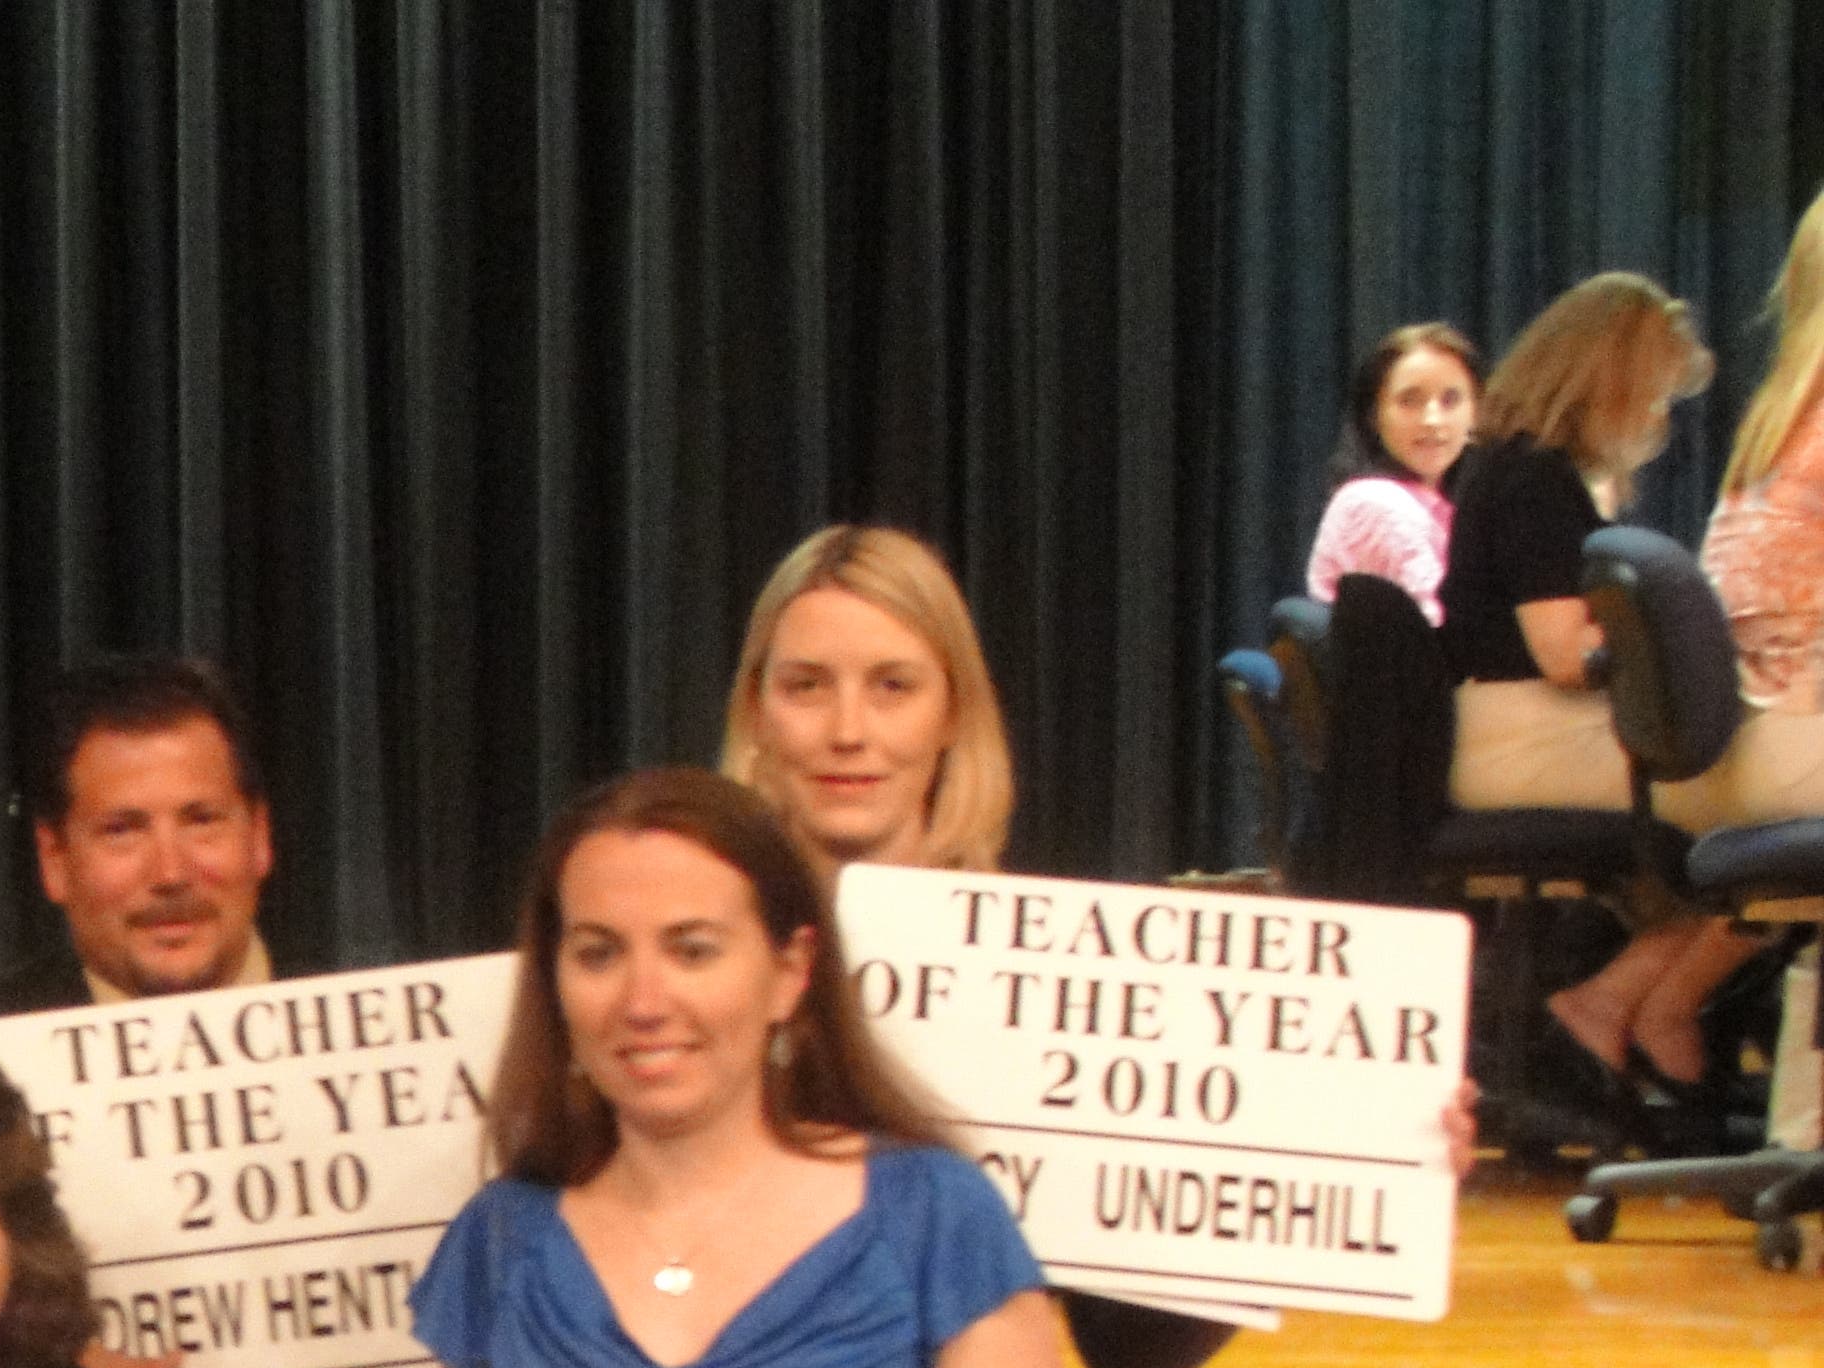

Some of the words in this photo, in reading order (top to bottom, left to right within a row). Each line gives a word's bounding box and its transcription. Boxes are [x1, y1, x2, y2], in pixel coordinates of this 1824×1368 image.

[952, 888, 1353, 979] TEACHER
[53, 980, 455, 1085] TEACHER
[856, 958, 957, 1020] OF
[993, 970, 1166, 1041] THE
[1204, 989, 1441, 1065] YEAR
[110, 1083, 281, 1160] THE
[317, 1057, 490, 1138] YEA
[1040, 1051, 1241, 1125] 2010
[173, 1151, 370, 1231] 2010
[1095, 1163, 1400, 1257] UNDERHILL
[91, 1279, 245, 1358] DREW
[263, 1260, 414, 1344] HENT
